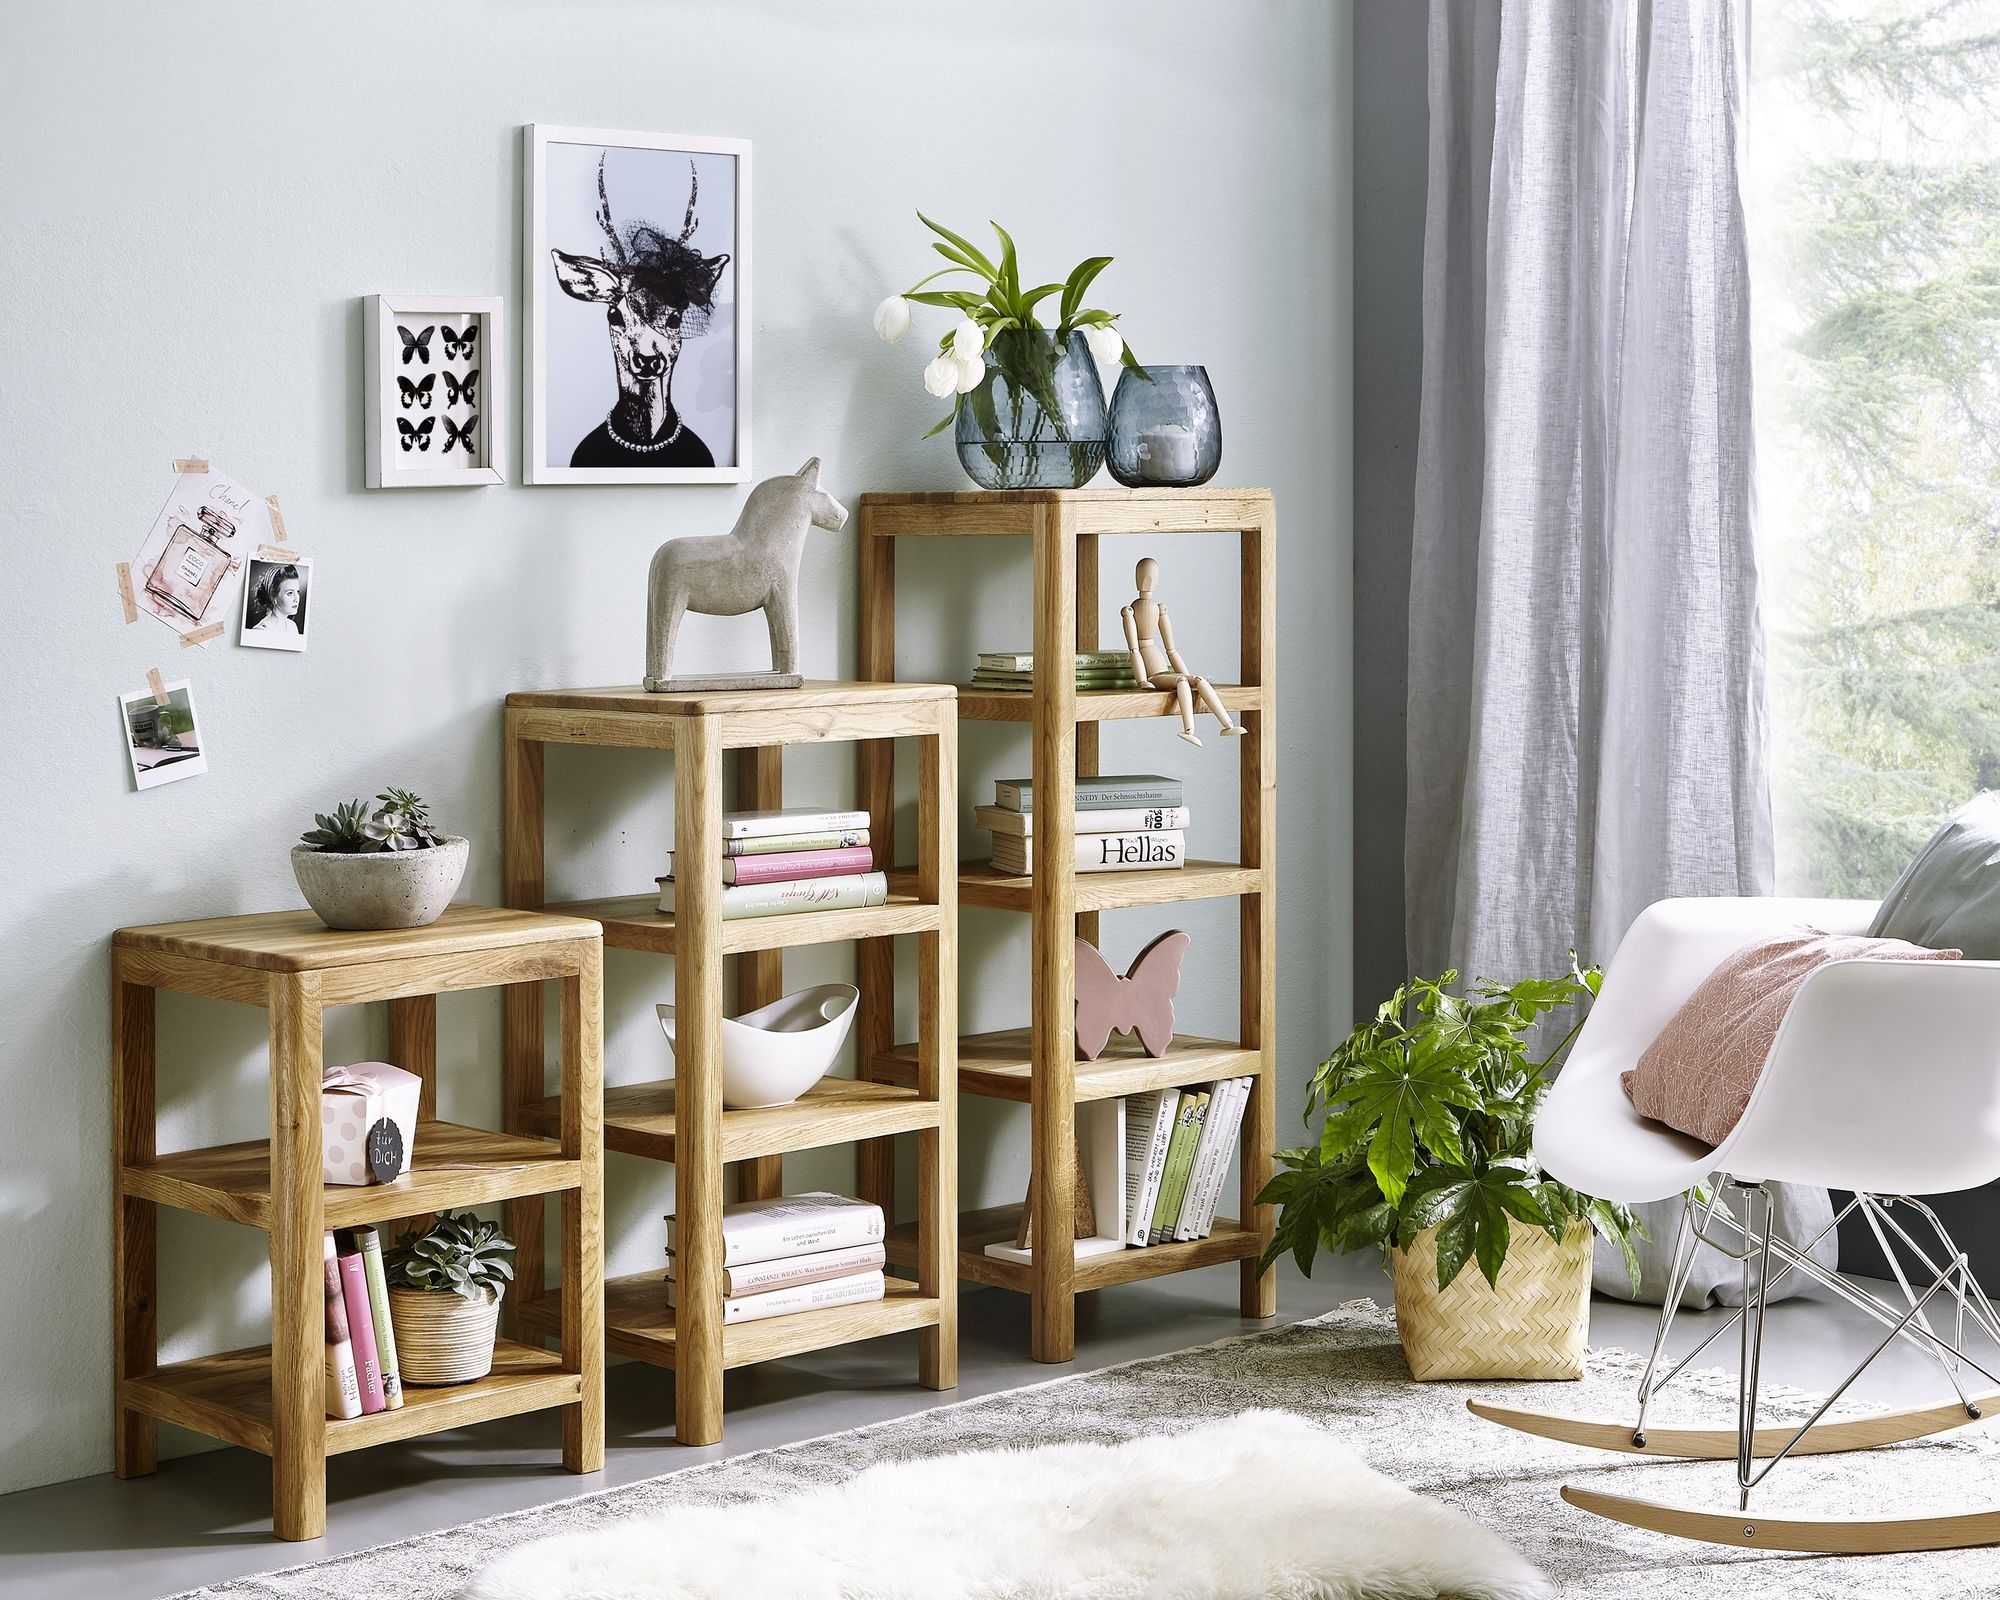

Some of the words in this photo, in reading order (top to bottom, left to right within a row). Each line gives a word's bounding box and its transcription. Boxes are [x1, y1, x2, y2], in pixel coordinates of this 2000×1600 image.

[209, 484, 250, 512] Chanel
[1100, 836, 1176, 864] Hellas
[376, 1130, 393, 1146] Für
[747, 1273, 780, 1285] CONSTANZE
[812, 1293, 824, 1303] DIE
[346, 1365, 358, 1401] Hörig
[364, 1359, 377, 1394] Fächer
